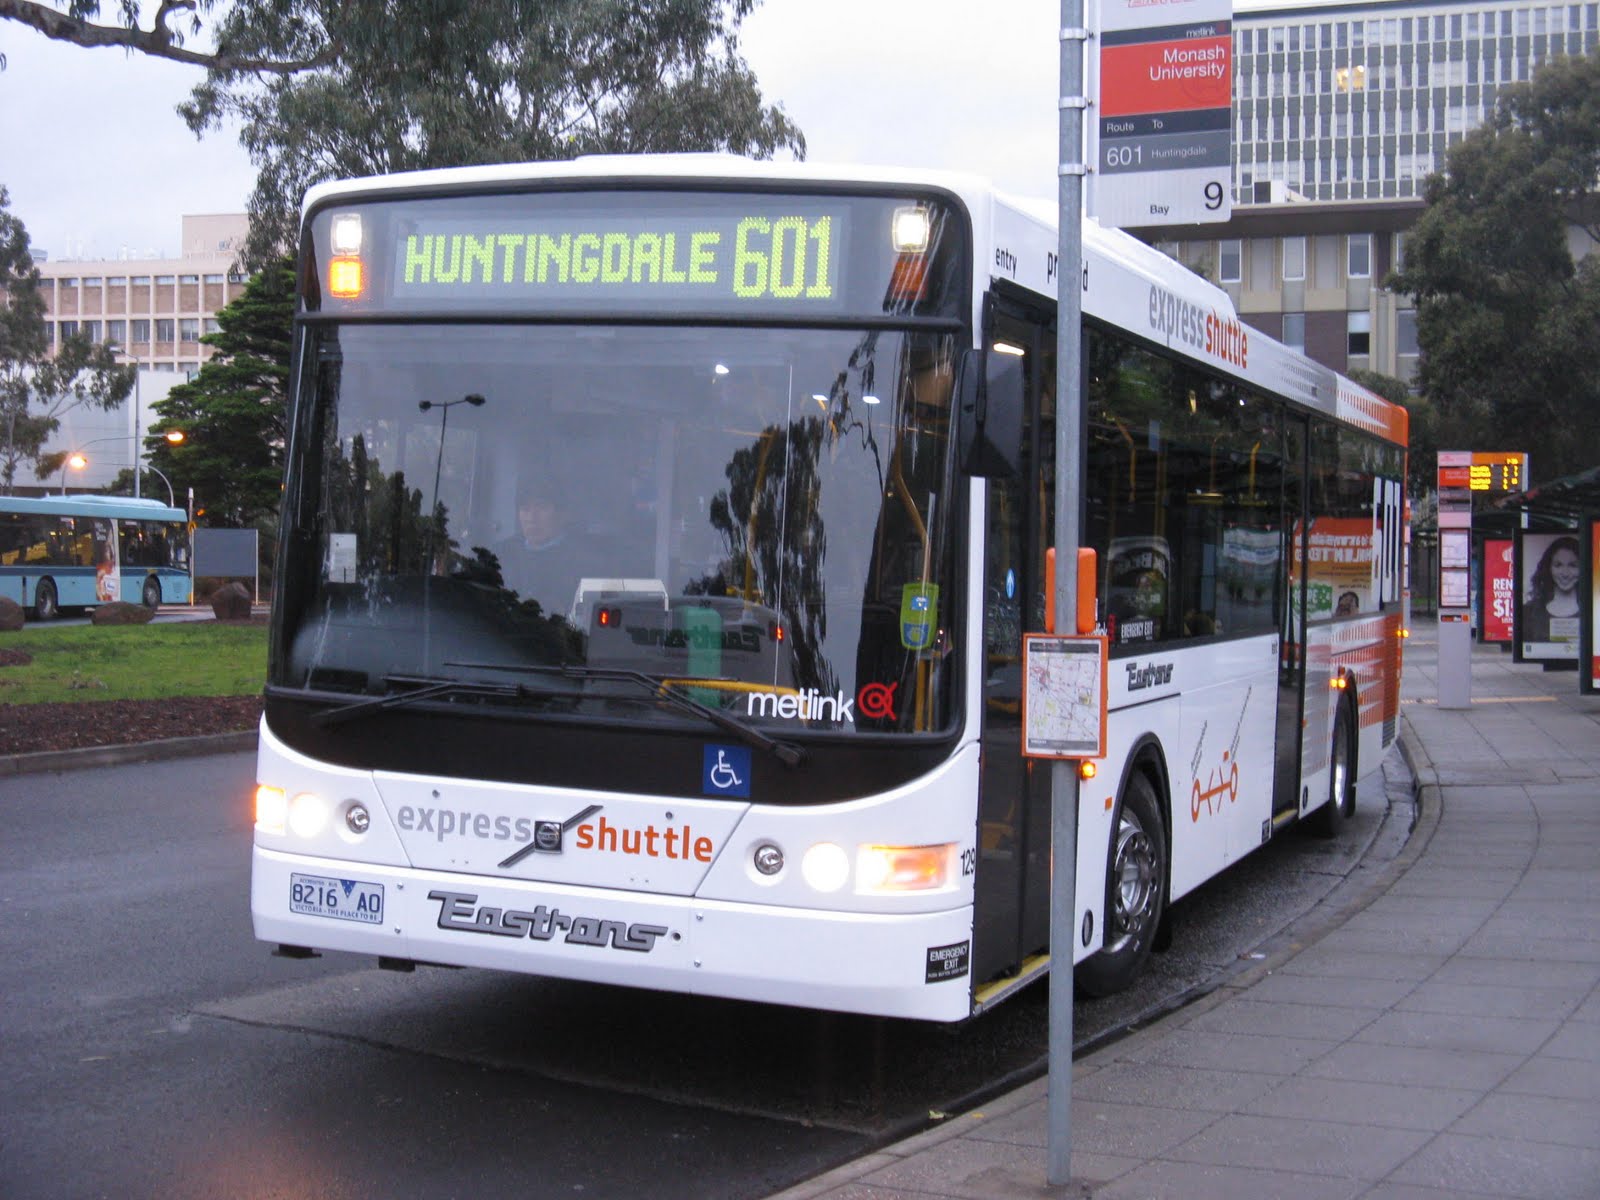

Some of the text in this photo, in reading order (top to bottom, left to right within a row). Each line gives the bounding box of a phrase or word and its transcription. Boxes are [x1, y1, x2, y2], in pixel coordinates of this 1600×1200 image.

[1164, 45, 1225, 64] Monash
[1150, 62, 1225, 81] University
[1106, 119, 1164, 132] Route To
[1106, 145, 1207, 167] 601 Huntingdale
[1150, 181, 1224, 215] Bay 9
[404, 215, 832, 299] HUNTINGDALE 601
[995, 247, 1018, 280] entry
[1148, 283, 1248, 370] express shuttle
[747, 687, 855, 723] metlink
[398, 803, 714, 862] express shuttle
[292, 883, 338, 907] 8216
[295, 903, 322, 913] VICTORIA
[327, 908, 339, 916] THE
[340, 910, 359, 919] PLACE
[360, 912, 369, 920] TO
[428, 890, 668, 952] Eastrans
[930, 944, 968, 962] EMERGENCY
[944, 958, 959, 971] EXIT
